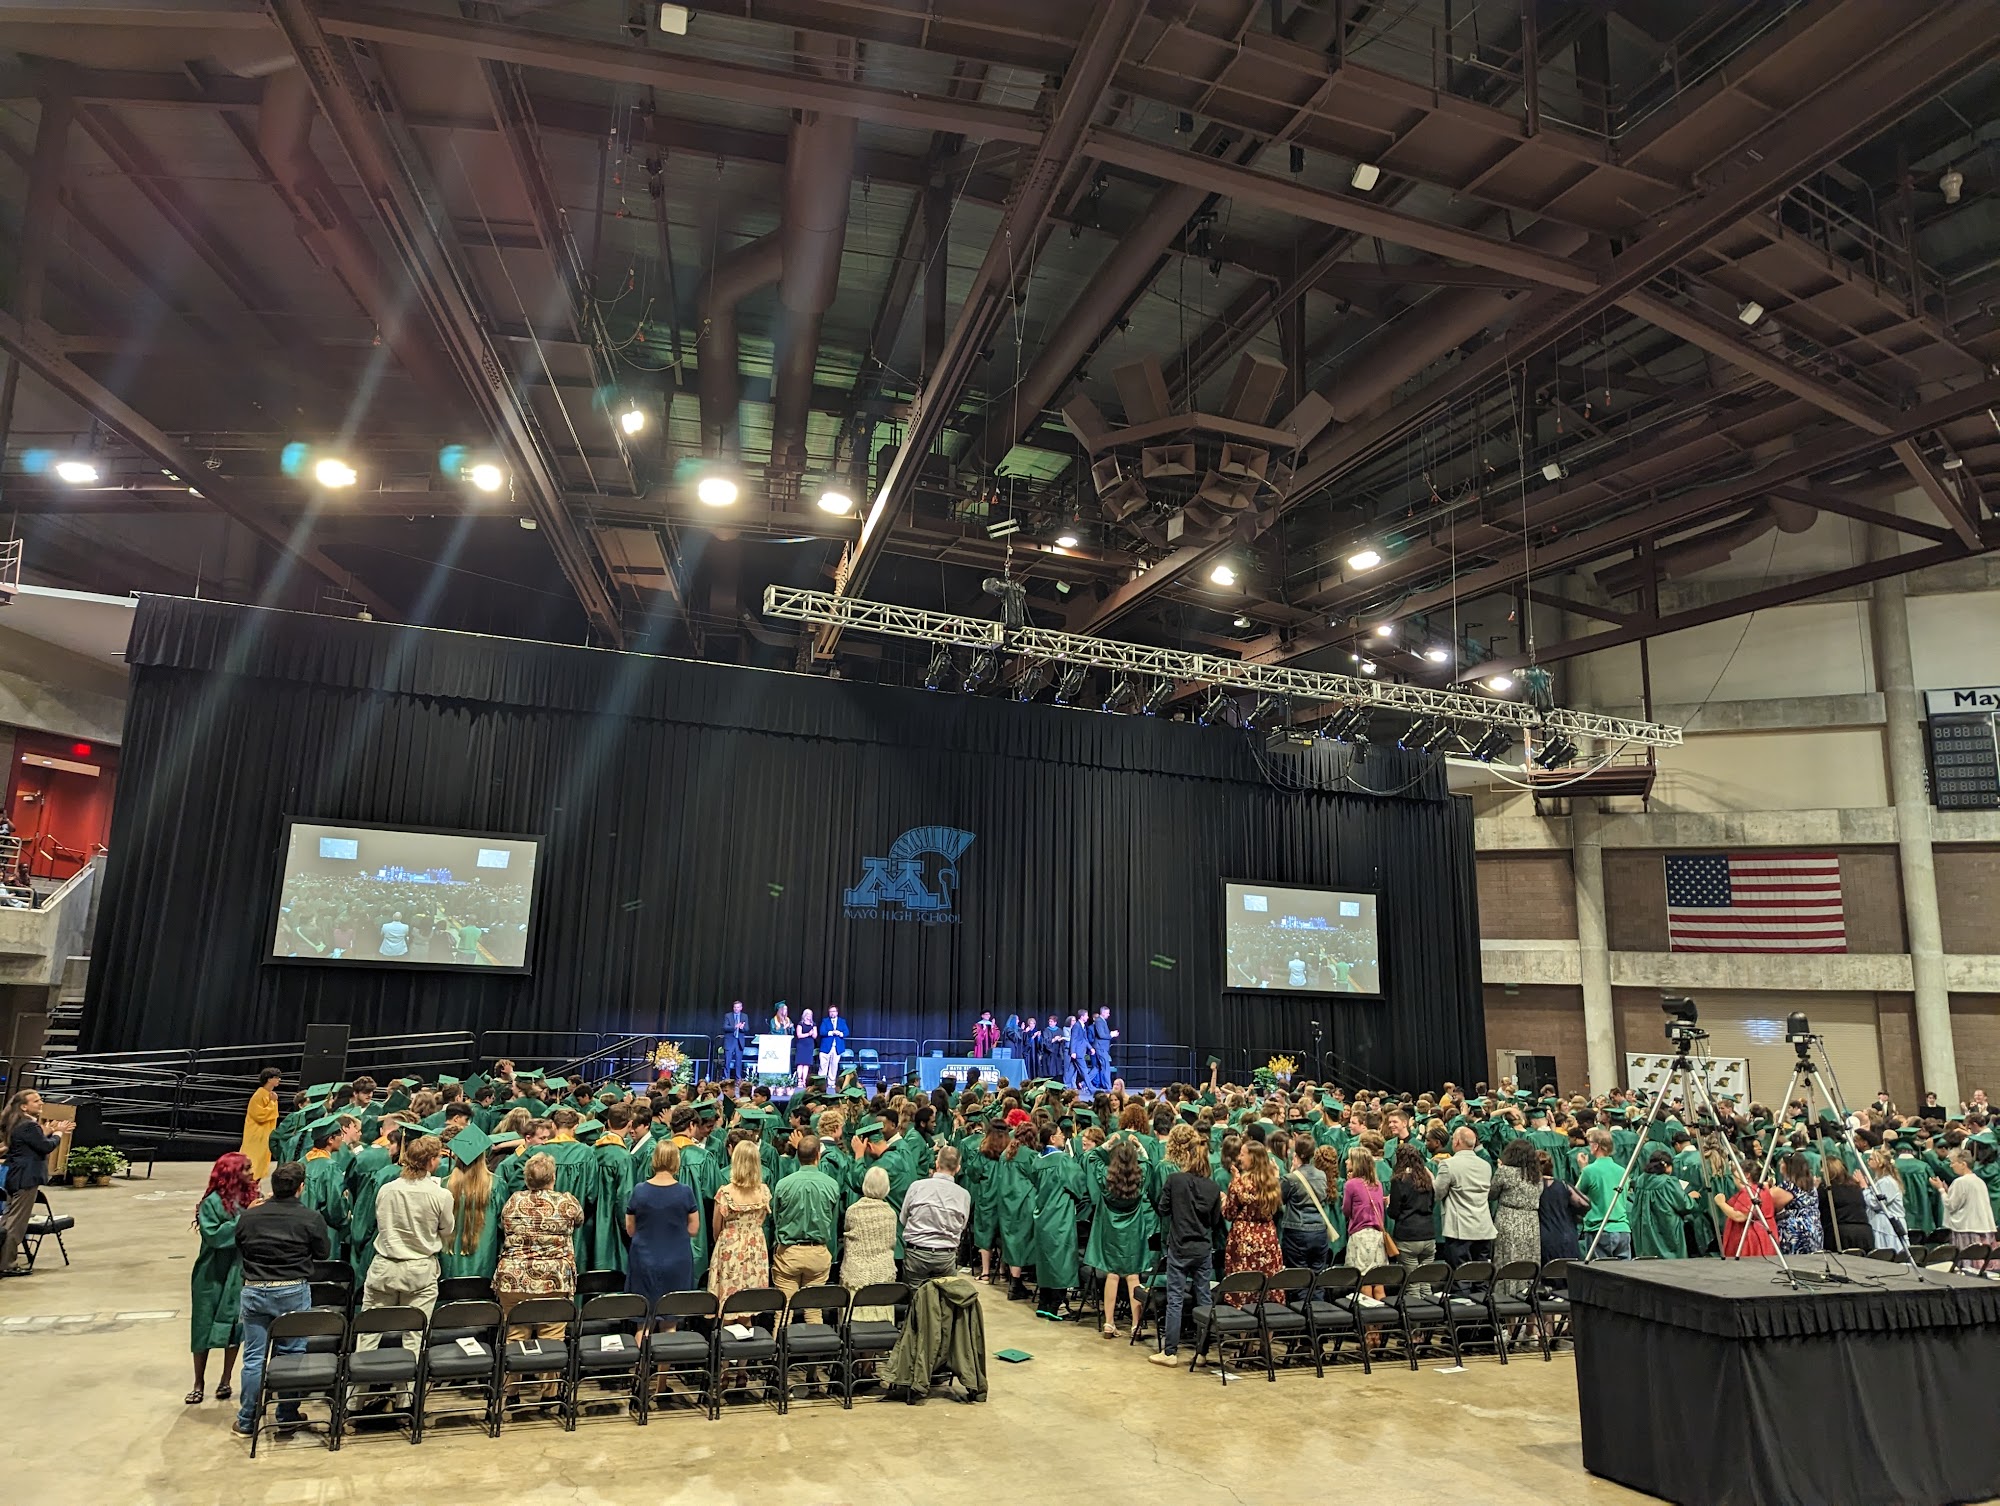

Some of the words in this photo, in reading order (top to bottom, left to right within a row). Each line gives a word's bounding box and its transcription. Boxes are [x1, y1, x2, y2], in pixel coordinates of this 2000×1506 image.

[843, 909, 878, 919] MAYO
[882, 909, 912, 920] HIGH
[917, 911, 963, 924] SCHOOL
